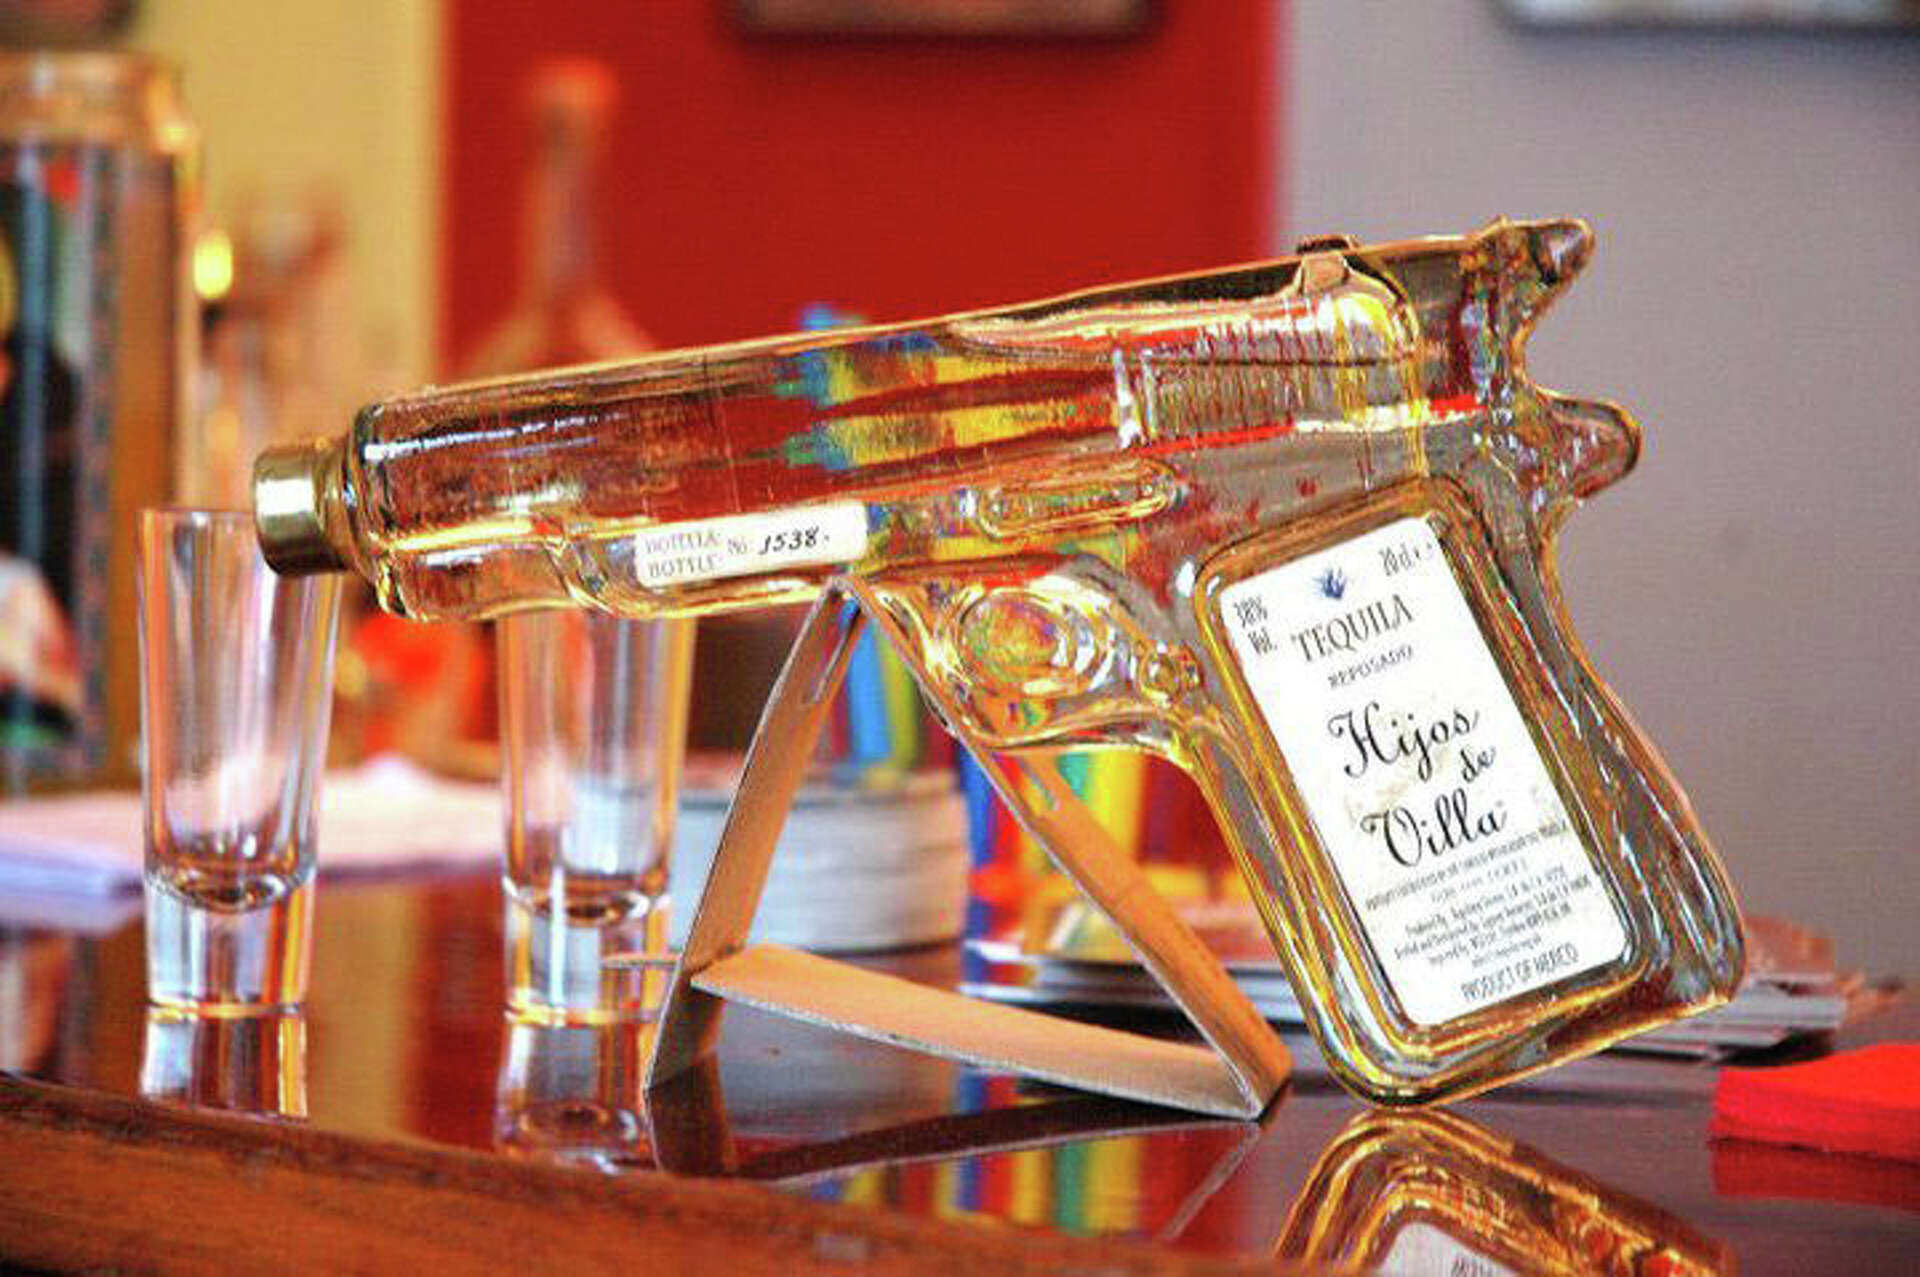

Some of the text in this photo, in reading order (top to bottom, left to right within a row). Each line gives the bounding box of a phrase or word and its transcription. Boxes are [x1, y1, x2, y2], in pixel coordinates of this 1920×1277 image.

[1290, 594, 1414, 662] TEQUILA
[1327, 643, 1413, 688] REPOSADO
[1327, 700, 1480, 782] Hijos
[1459, 746, 1497, 783] de
[1359, 787, 1508, 868] Villa
